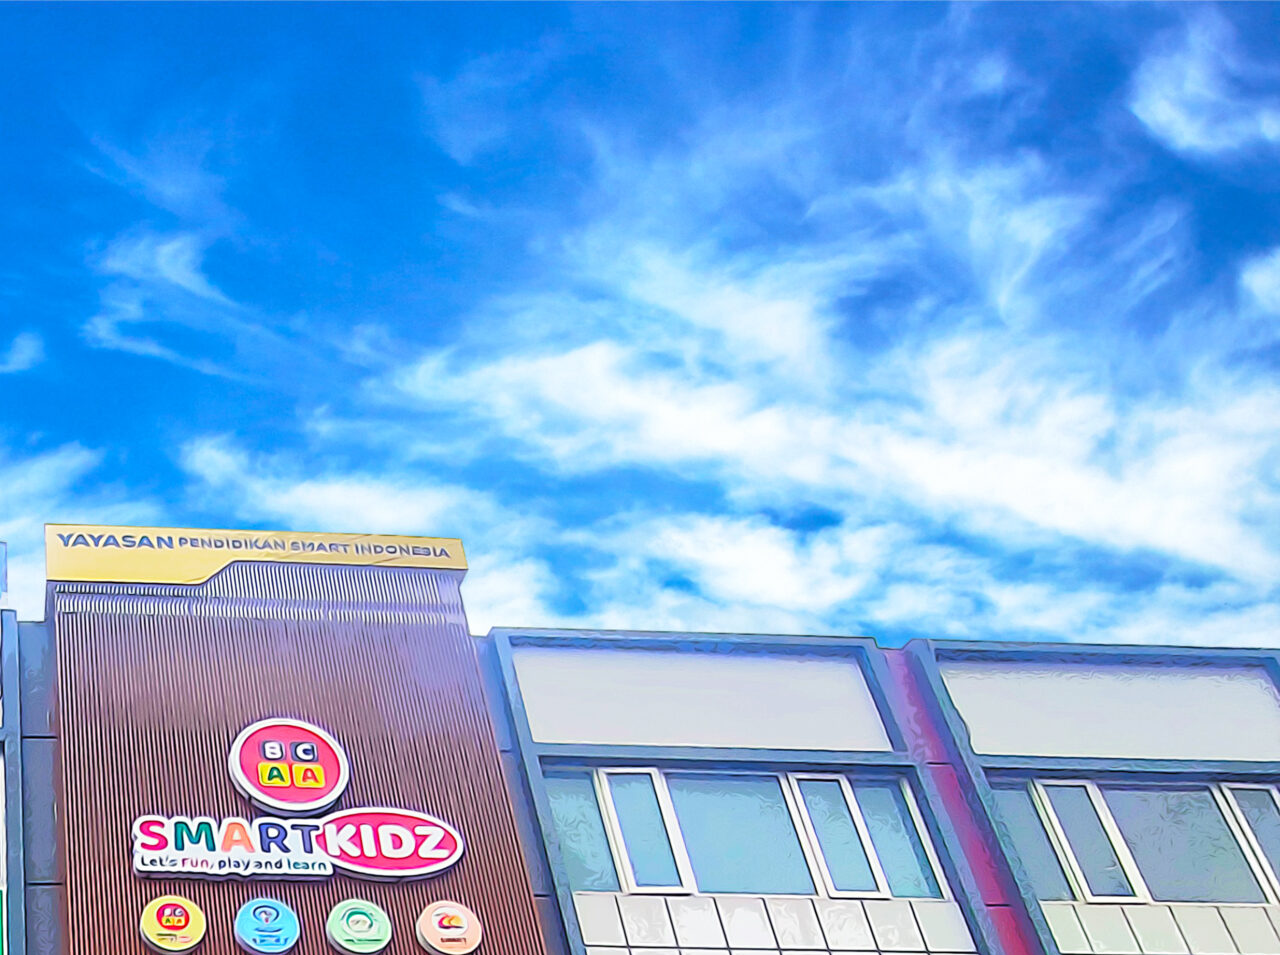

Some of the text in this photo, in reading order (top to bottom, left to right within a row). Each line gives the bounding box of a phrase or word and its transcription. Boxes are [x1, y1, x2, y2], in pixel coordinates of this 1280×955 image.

[56, 532, 451, 559] YAYASAN PENDIDIKAN SMART INDONESIA
[140, 855, 178, 869] Let's
[217, 855, 251, 872] play
[253, 859, 283, 870] and
[286, 858, 328, 872] learn
